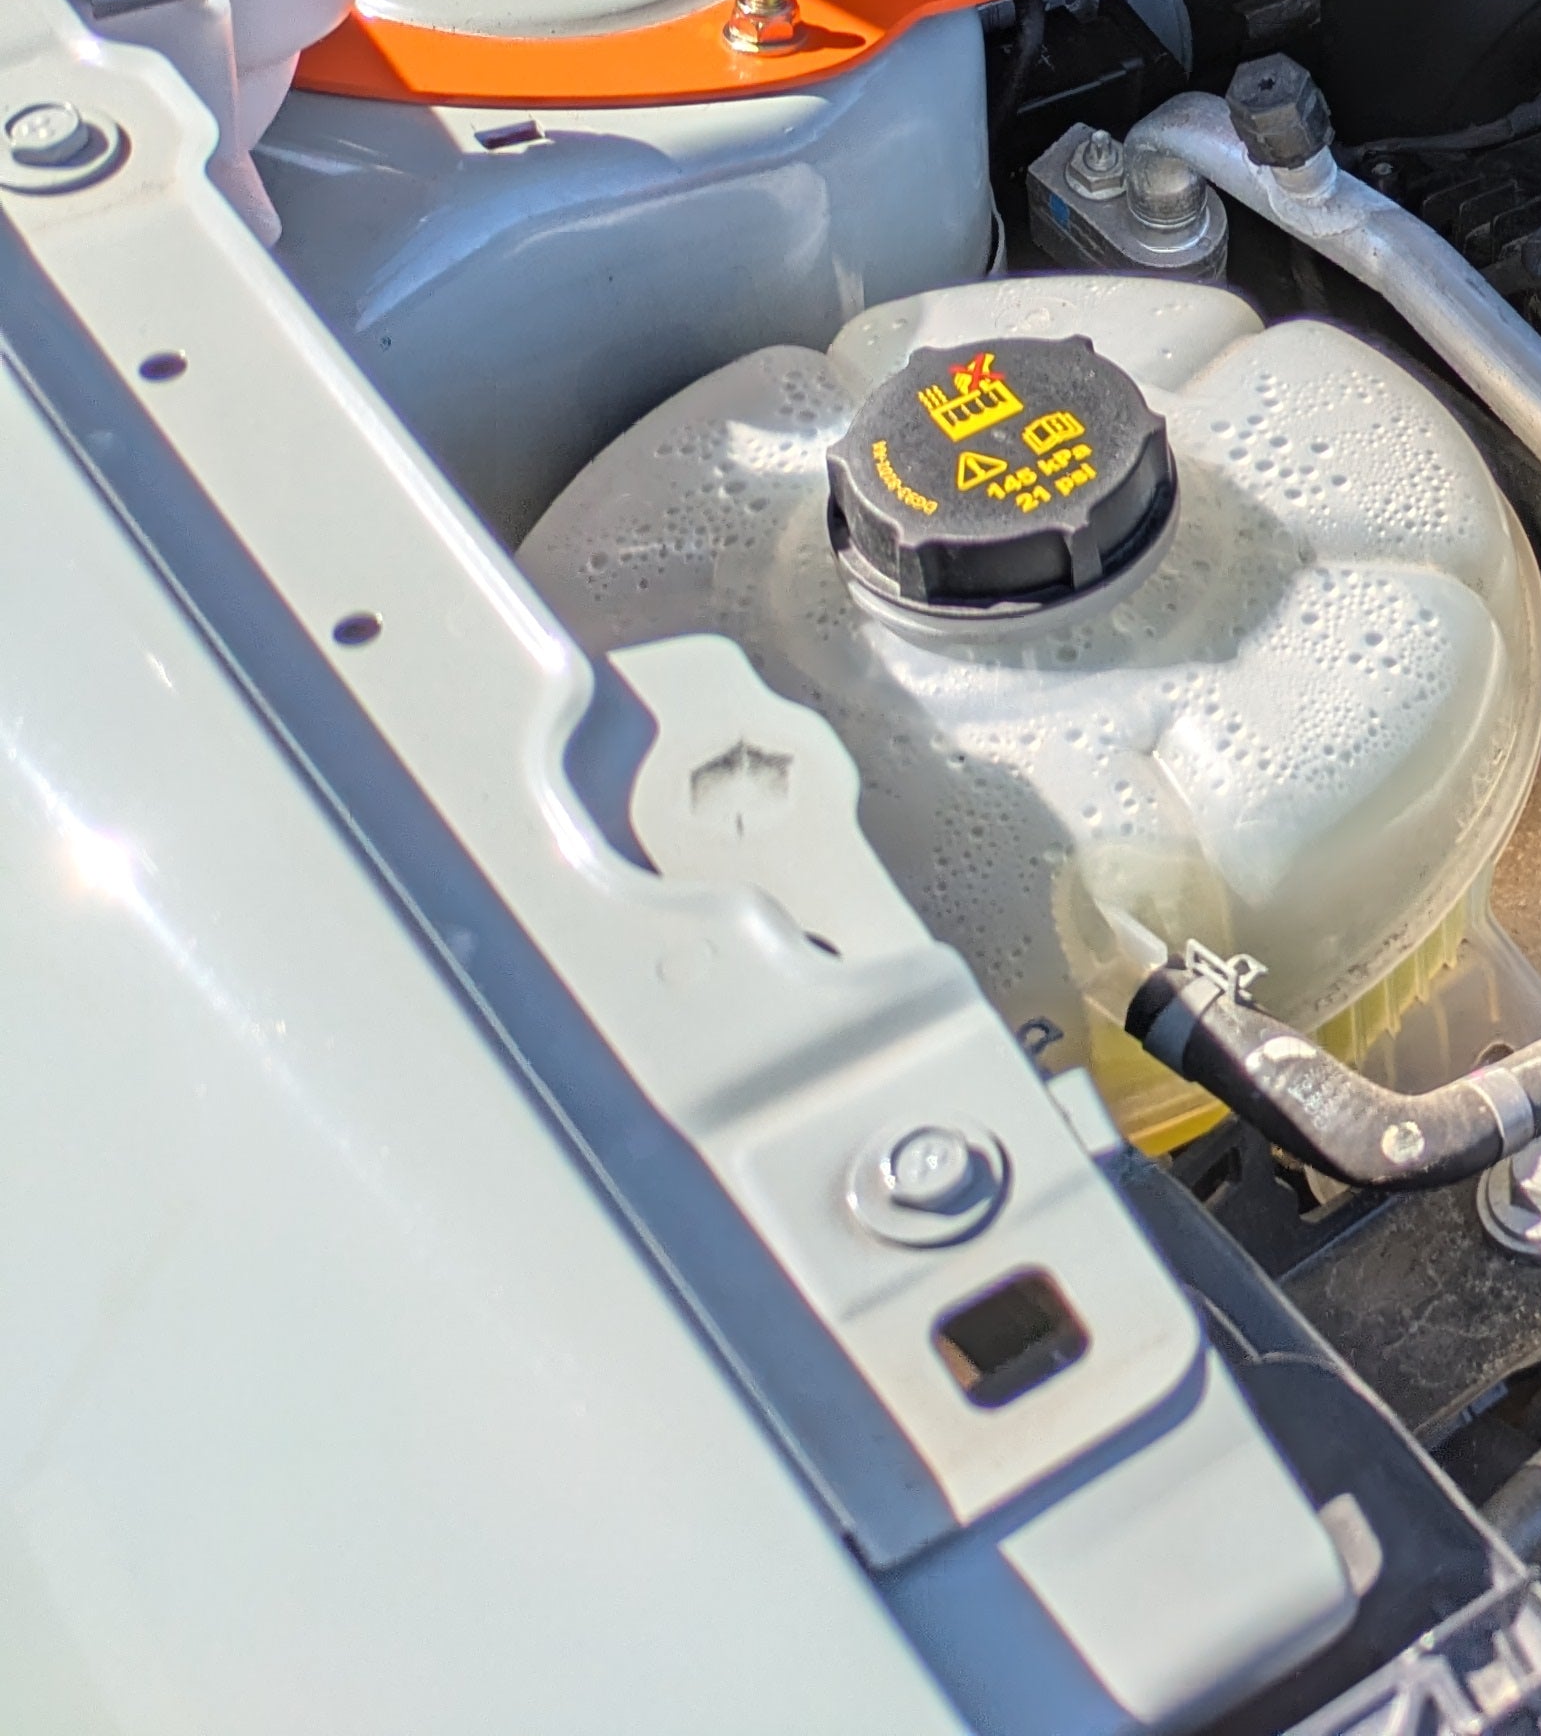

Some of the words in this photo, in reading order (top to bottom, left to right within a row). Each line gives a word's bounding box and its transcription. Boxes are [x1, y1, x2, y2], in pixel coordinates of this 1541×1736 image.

[986, 465, 1039, 501] 145
[1036, 442, 1094, 477] kPa
[1014, 484, 1052, 514] 21
[1052, 461, 1099, 497] psi
